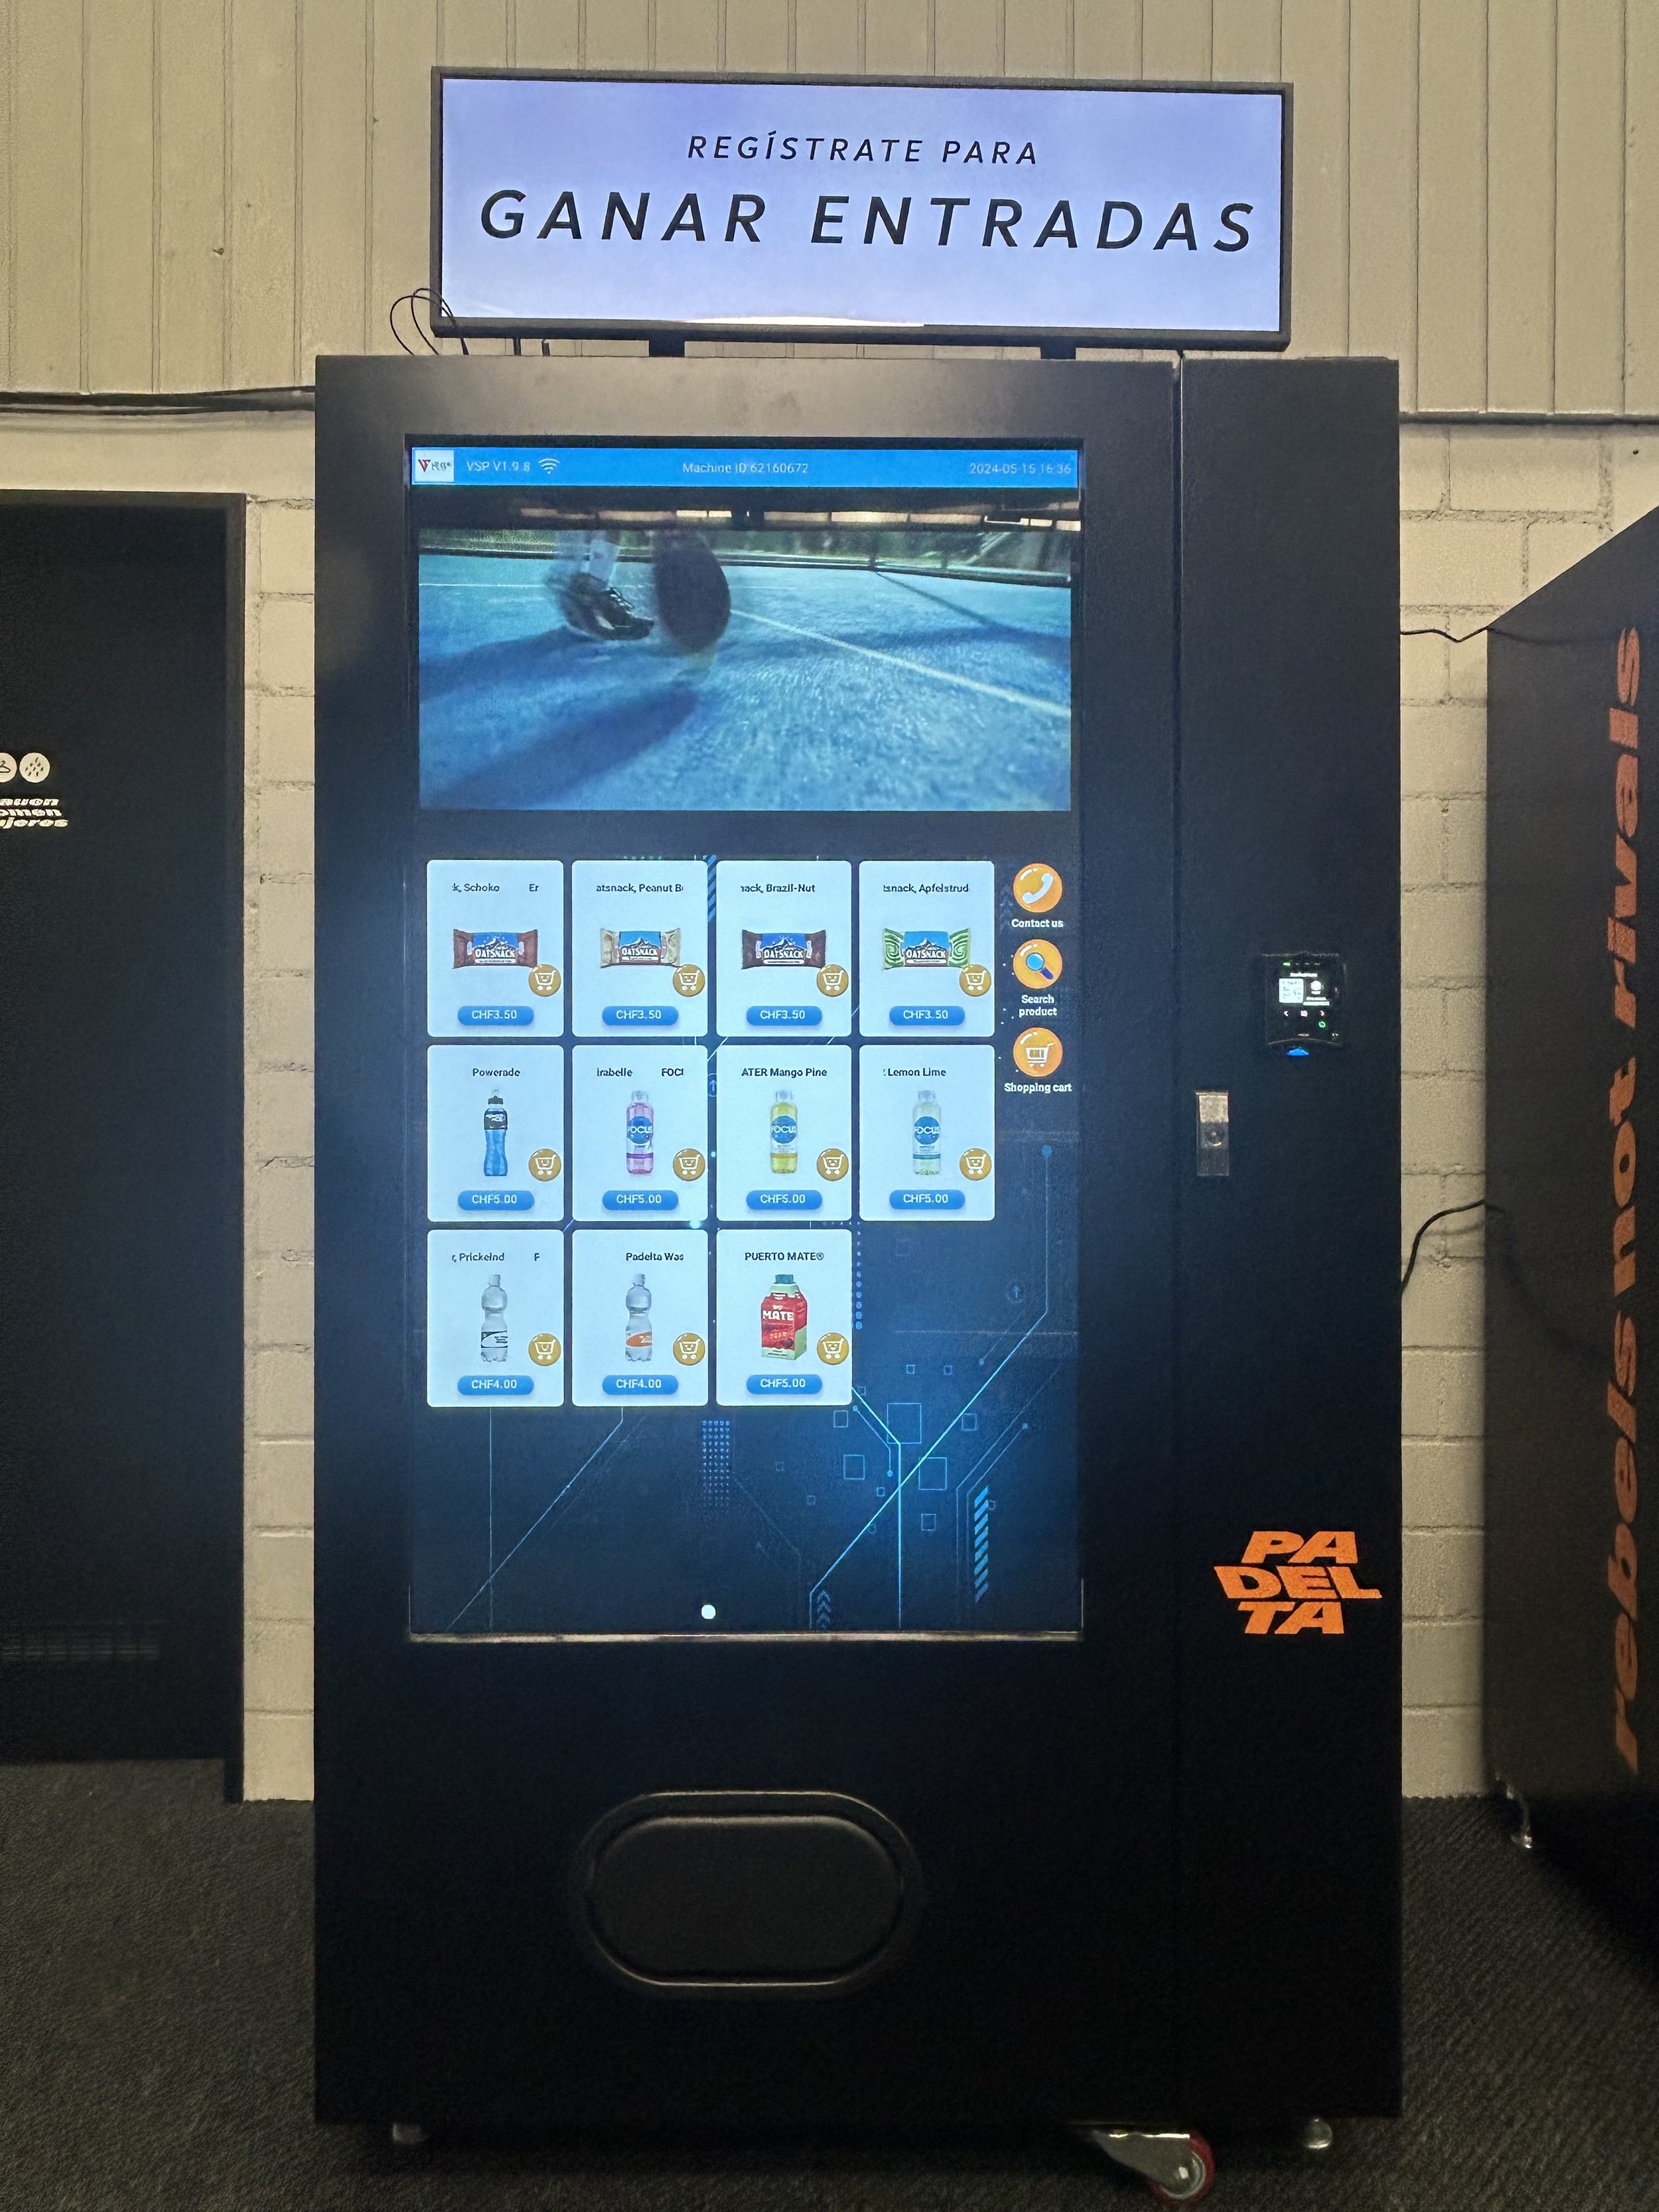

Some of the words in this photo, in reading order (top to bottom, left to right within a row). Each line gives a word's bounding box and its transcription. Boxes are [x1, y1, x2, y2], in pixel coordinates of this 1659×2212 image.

[688, 130, 923, 162] REGÍSTRATE
[942, 141, 1036, 165] PARA
[480, 189, 766, 243] GANAR
[810, 195, 1254, 252] ENTRADAS
[467, 461, 490, 472] VSP
[493, 461, 530, 473] V1.98
[682, 462, 731, 473] Machine
[970, 463, 1036, 475] 2024-0515
[1041, 463, 1071, 475] 1636
[1607, 626, 1640, 1029] rivals
[464, 883, 500, 892] Schoko
[639, 883, 673, 893] Peanut
[675, 883, 684, 892] B
[766, 883, 816, 893] Brazil-Nut
[918, 883, 969, 895] Apfelstrud
[1011, 918, 1050, 928] Contact
[1050, 920, 1064, 928] us
[1021, 994, 1055, 1004] Search
[472, 1009, 518, 1020] CHF3.50
[616, 1009, 662, 1020] CHF3.50
[760, 1009, 806, 1020] CHF3.50
[903, 1009, 949, 1020] CHF3.50
[1019, 1006, 1058, 1018] product
[472, 1067, 521, 1076] Powerade
[741, 1068, 768, 1076] ATER
[770, 1067, 803, 1078] Mango
[805, 1067, 828, 1076] Pine
[888, 1068, 920, 1076] Lemon
[922, 1067, 947, 1076] Lime
[1004, 1082, 1051, 1095] Shopping
[1052, 1083, 1072, 1093] cart
[1609, 1055, 1637, 1297] not
[472, 1194, 518, 1204] CHF5.00
[616, 1194, 662, 1204] CHF5.00
[760, 1194, 806, 1204] CHF5.00
[903, 1194, 949, 1204] CHF5.00
[459, 1252, 504, 1262] Prickelnd
[626, 1252, 662, 1261] Padelta
[745, 1252, 785, 1260] PUERTO
[762, 1310, 795, 1321] MATE
[471, 1378, 517, 1389] CHF4.00
[616, 1378, 662, 1389] CHF4.00
[760, 1378, 806, 1389] CHF5.00
[1241, 1530, 1358, 1564] PA
[1607, 1310, 1639, 1775] rebels
[1213, 1566, 1383, 1599] DEL
[1237, 1601, 1344, 1635] TA
